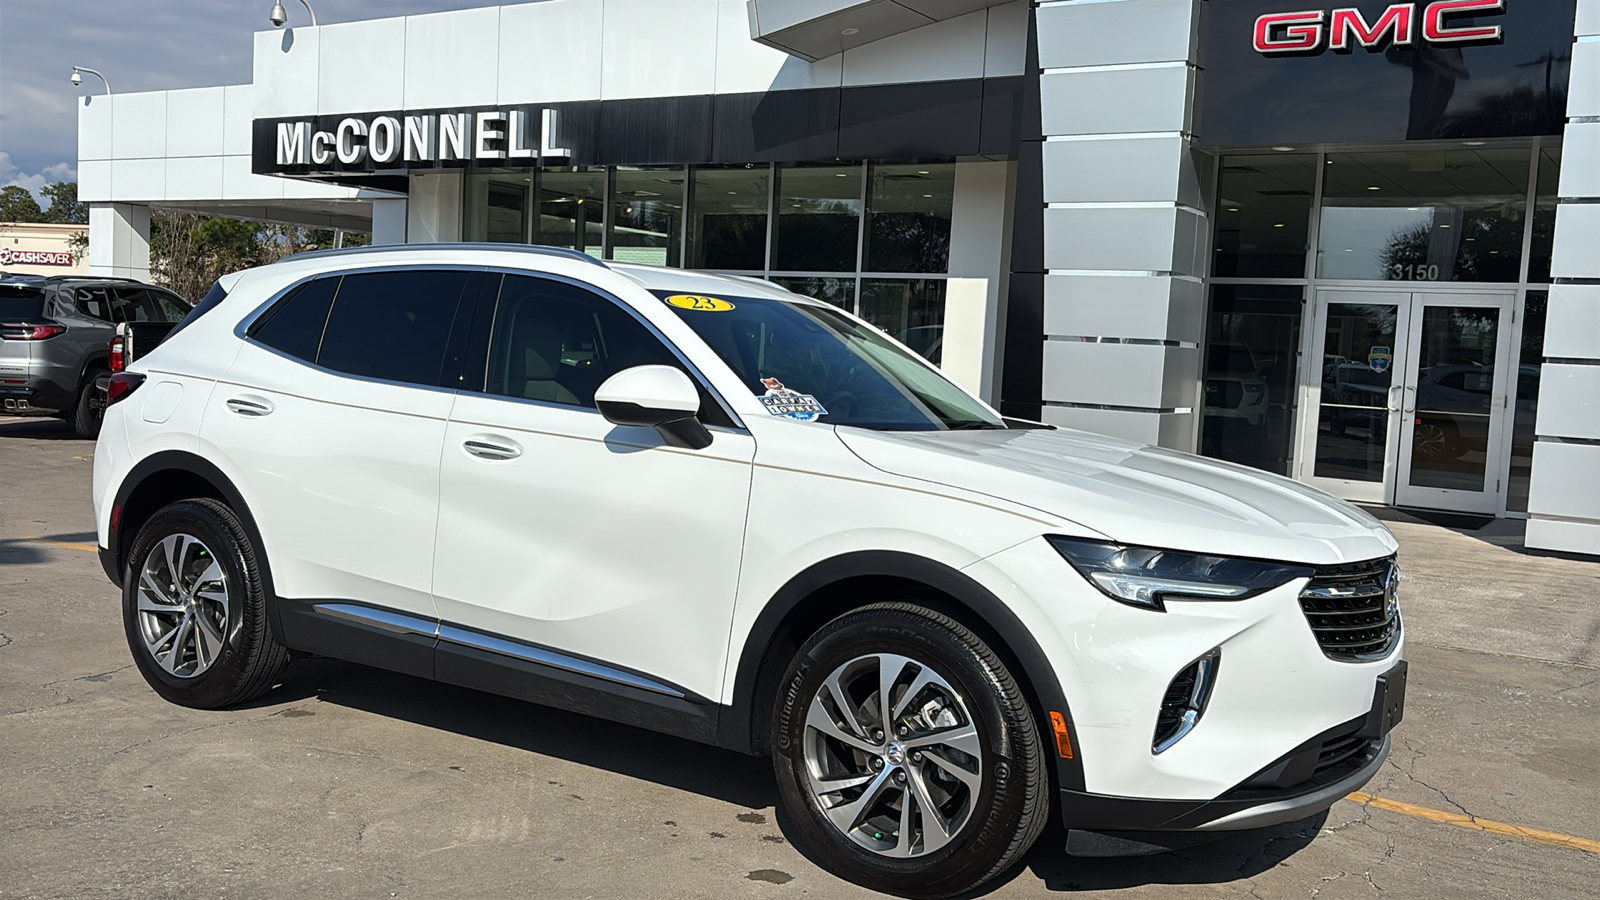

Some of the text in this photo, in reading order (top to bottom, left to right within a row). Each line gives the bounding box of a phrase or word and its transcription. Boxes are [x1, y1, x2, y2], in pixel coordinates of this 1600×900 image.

[1253, 0, 1502, 52] GMC
[1391, 263, 1439, 280] 3150
[686, 296, 716, 309] 23
[778, 671, 804, 749] Continental
